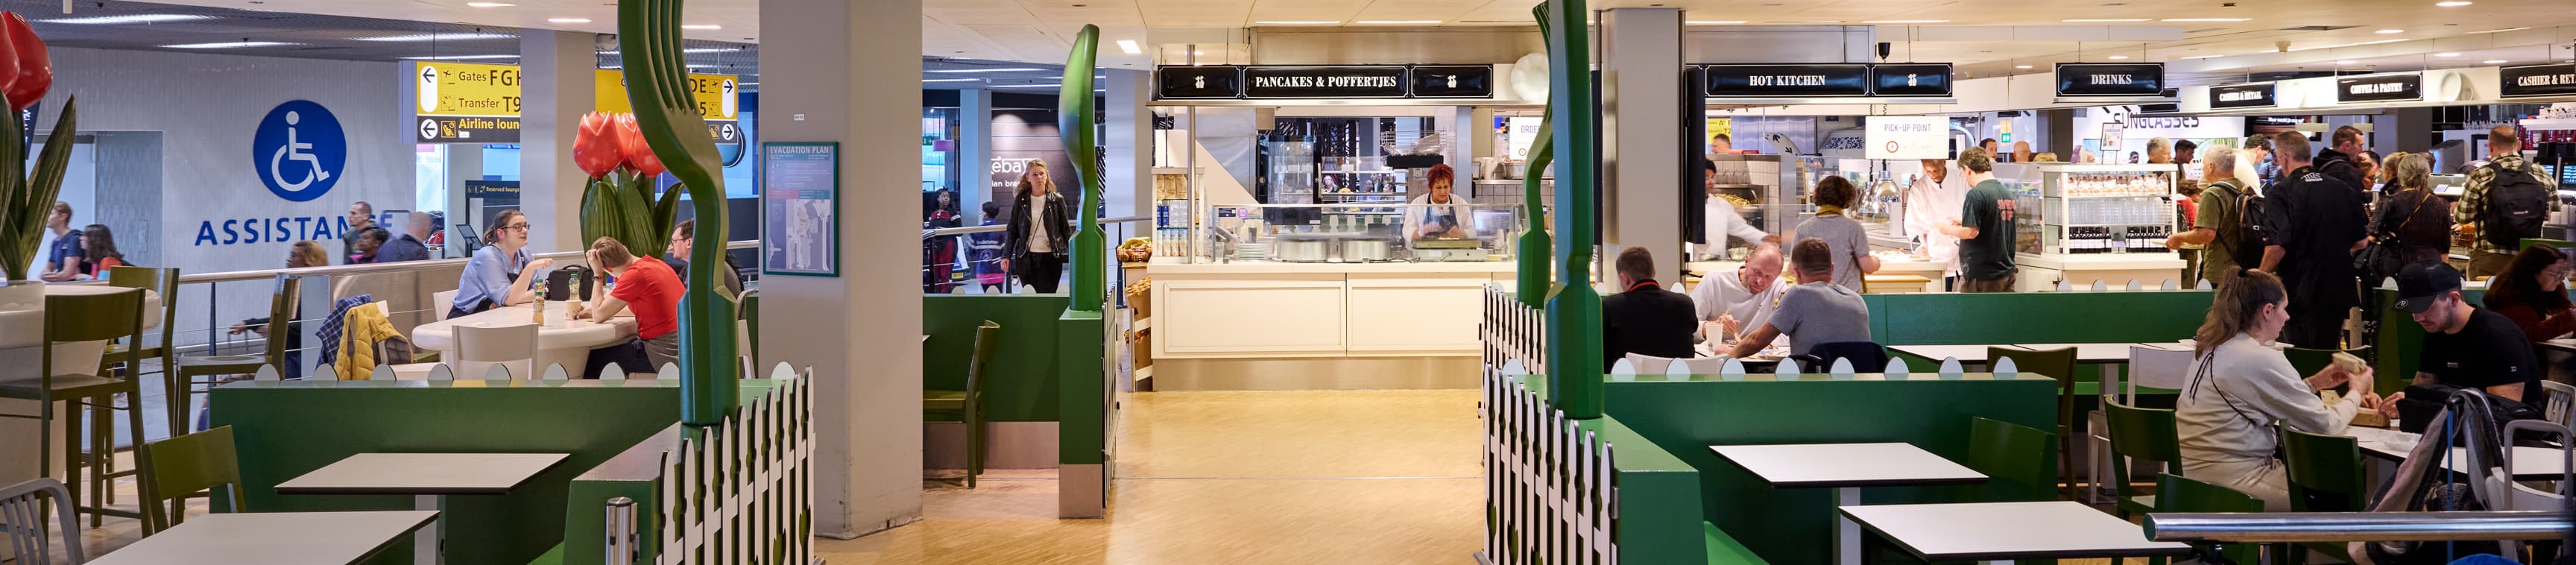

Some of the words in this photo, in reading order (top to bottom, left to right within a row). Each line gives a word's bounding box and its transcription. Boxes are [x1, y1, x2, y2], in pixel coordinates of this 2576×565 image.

[458, 72, 486, 81] Gates
[1256, 76, 1313, 87] PANCAKES
[1316, 76, 1325, 86] &
[1328, 76, 1396, 87] POFFERTJES
[1749, 75, 1772, 86] HOT
[1777, 75, 1825, 86] KITCHEN
[2091, 75, 2132, 85] DRINKS
[2518, 75, 2550, 86] CASHIER
[2551, 75, 2558, 85] &
[2560, 74, 2576, 84] RET
[2379, 82, 2403, 92] PASTRY
[458, 98, 499, 108] Transfer
[458, 119, 493, 129] Airline
[497, 119, 521, 130] loun
[1884, 124, 1910, 132] PICK-UP
[1913, 124, 1931, 132] POINT
[770, 146, 810, 154] EVACUATION
[812, 145, 829, 154] PLAN
[991, 157, 1027, 174] ebay
[195, 214, 394, 246] ASSISTANE
